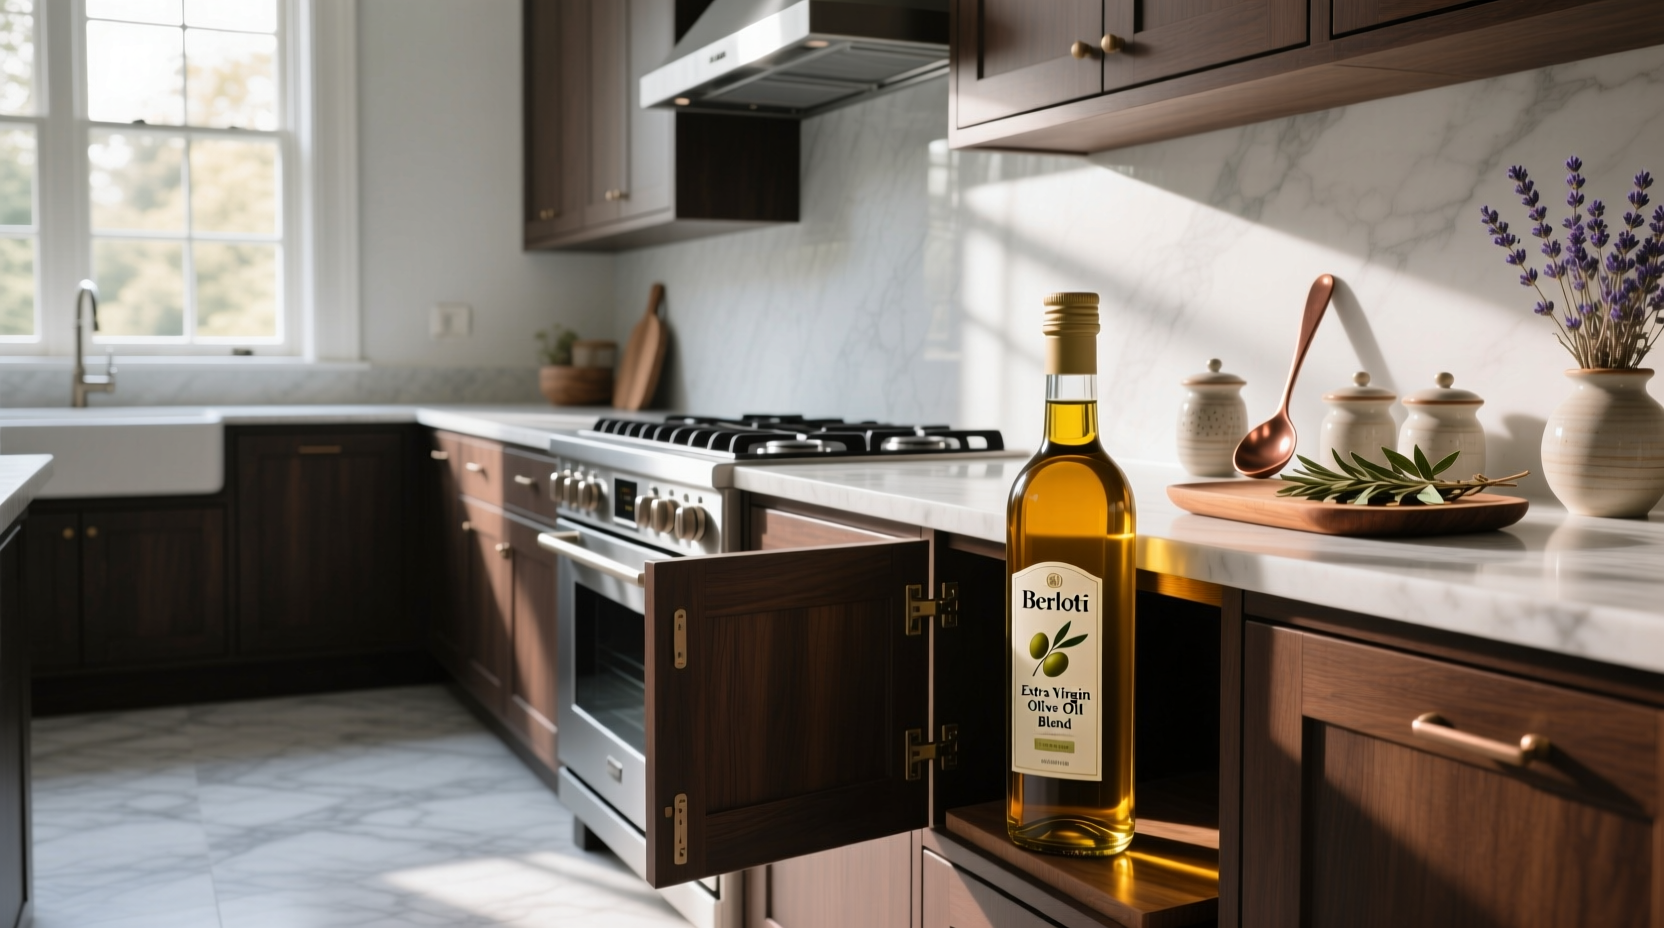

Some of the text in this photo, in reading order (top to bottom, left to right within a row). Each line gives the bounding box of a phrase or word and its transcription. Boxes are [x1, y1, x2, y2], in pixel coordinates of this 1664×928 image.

[1022, 590, 1089, 612] Berloti
[1021, 684, 1091, 704] Extra Virgin
[1028, 699, 1059, 712] Olive
[1038, 716, 1072, 729] Blend
